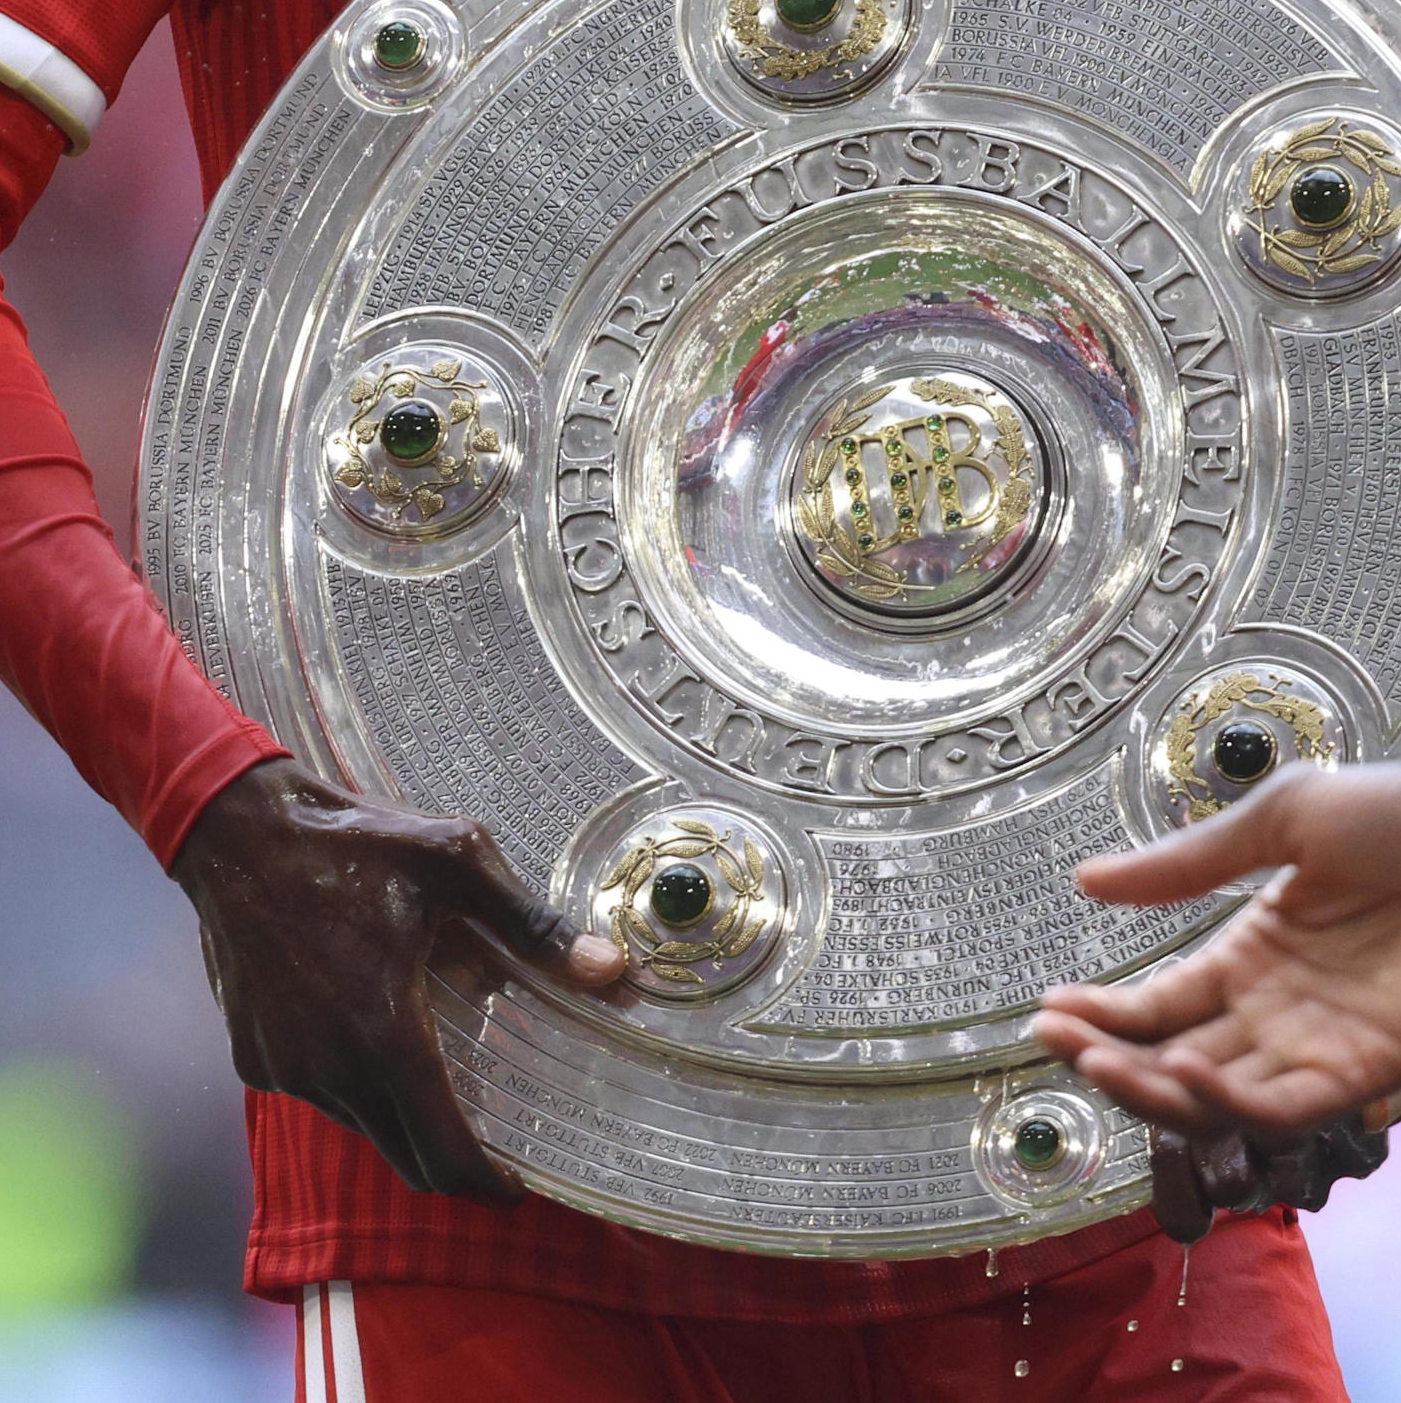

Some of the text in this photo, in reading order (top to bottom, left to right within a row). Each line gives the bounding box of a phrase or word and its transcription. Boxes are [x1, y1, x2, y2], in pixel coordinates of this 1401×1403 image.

[1265, 6, 1299, 36] 1906
[407, 13, 673, 305] 1938 HANNOVER 96 1939 SCHALKE 04 1940
[188, 71, 320, 303] 1996 BV BORUSSIA DORTMUND
[202, 101, 328, 344] 2011 BV BORUSSIA DORTMUND
[235, 108, 351, 318] 2026 FC BAYERN MÜNCHEN
[147, 325, 192, 576] 1995 BV BORUSSIA DORTMUND
[199, 328, 243, 554] 2025 FC BAYERN MÜNCHEN
[659, 129, 1243, 782] FUSSBALLMEISTER
[173, 365, 207, 594] 2010 FC BAYERN MÜNCHEN
[200, 571, 225, 678] LEVERKUSEN
[504, 1072, 587, 1120] MÜNCHEN
[513, 1107, 609, 1159] STUTTGART
[590, 1113, 654, 1144] BAYERN
[655, 1135, 680, 1152] FC
[683, 1142, 717, 1160] 2022
[502, 1132, 673, 1205] 1992 VFB STUTTGART
[612, 1150, 647, 1171] VFB
[731, 1152, 819, 1176] MÜNCHEN
[827, 1160, 894, 1173] BAYERN
[899, 1158, 919, 1172] FC
[722, 1177, 960, 1201] 2006 FC BAYERN MÜNCHEN
[729, 1206, 881, 1225] KAISERSLAUTERN
